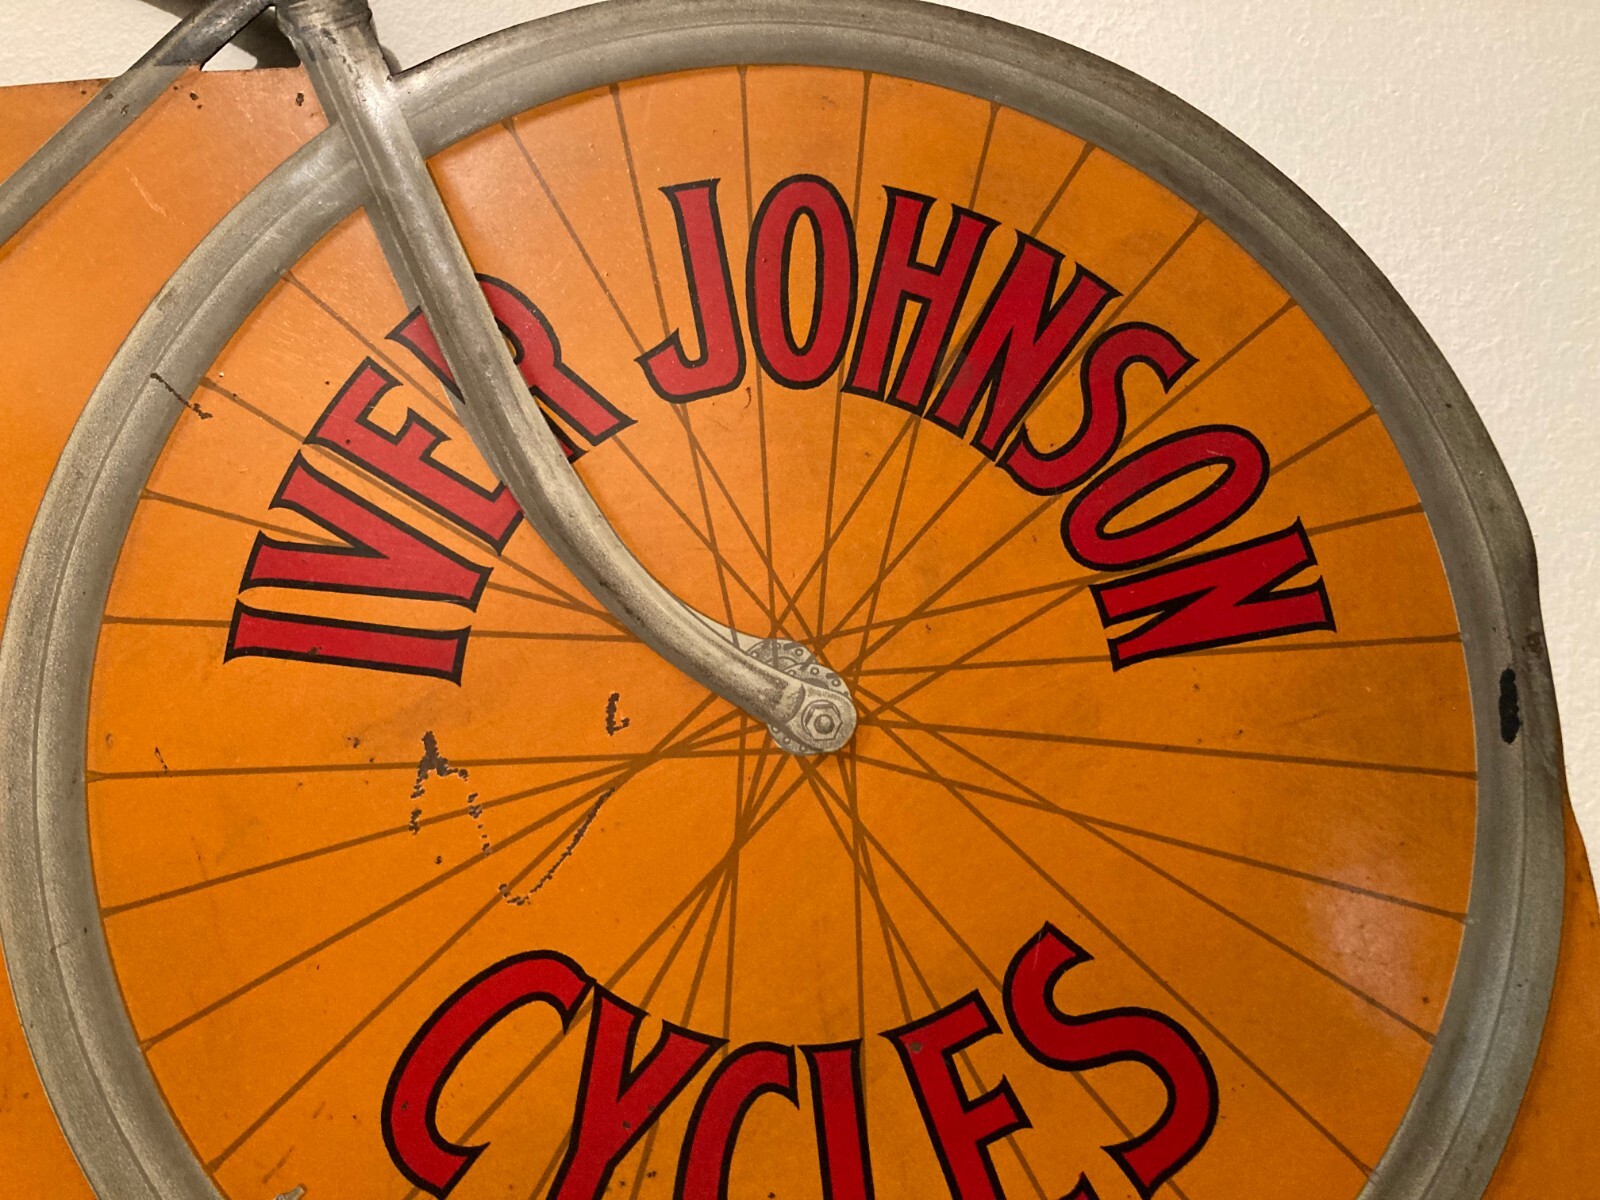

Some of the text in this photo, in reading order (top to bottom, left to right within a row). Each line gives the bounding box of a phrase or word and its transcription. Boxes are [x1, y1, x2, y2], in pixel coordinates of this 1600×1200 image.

[224, 174, 1336, 686] IVER JOHNSON
[381, 921, 1219, 1200] CYCLES
